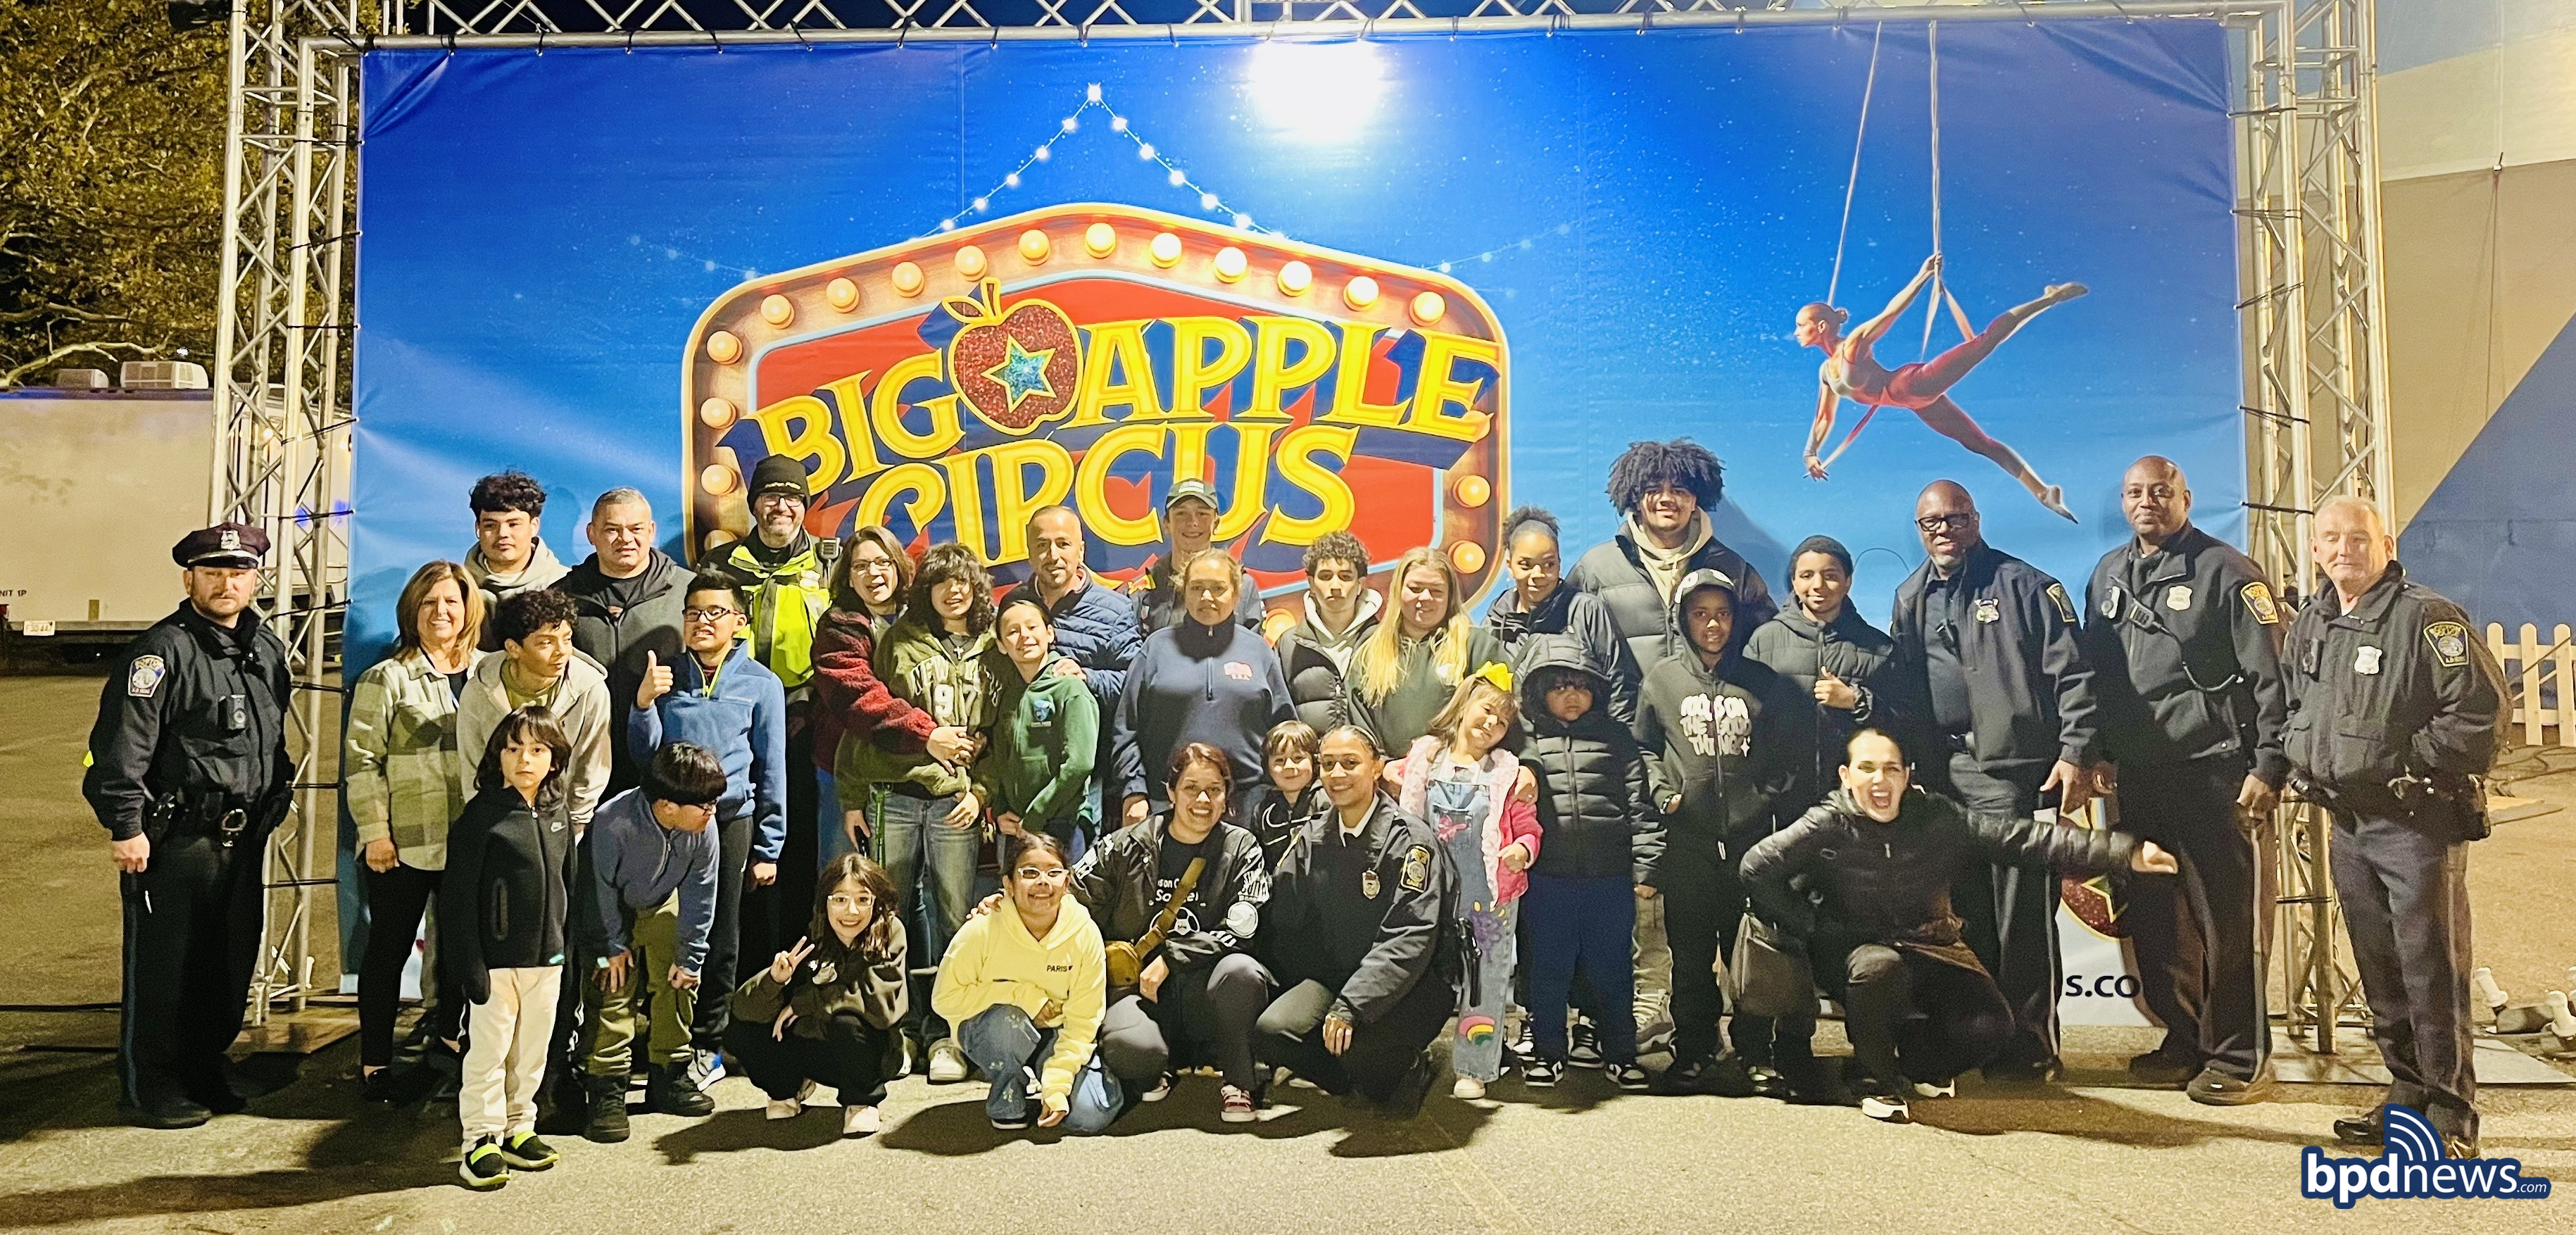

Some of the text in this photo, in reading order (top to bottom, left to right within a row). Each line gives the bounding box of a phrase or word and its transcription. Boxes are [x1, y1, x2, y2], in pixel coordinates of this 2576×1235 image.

[739, 315, 1502, 496] BIG APPLE
[1155, 889, 1199, 902] Soer
